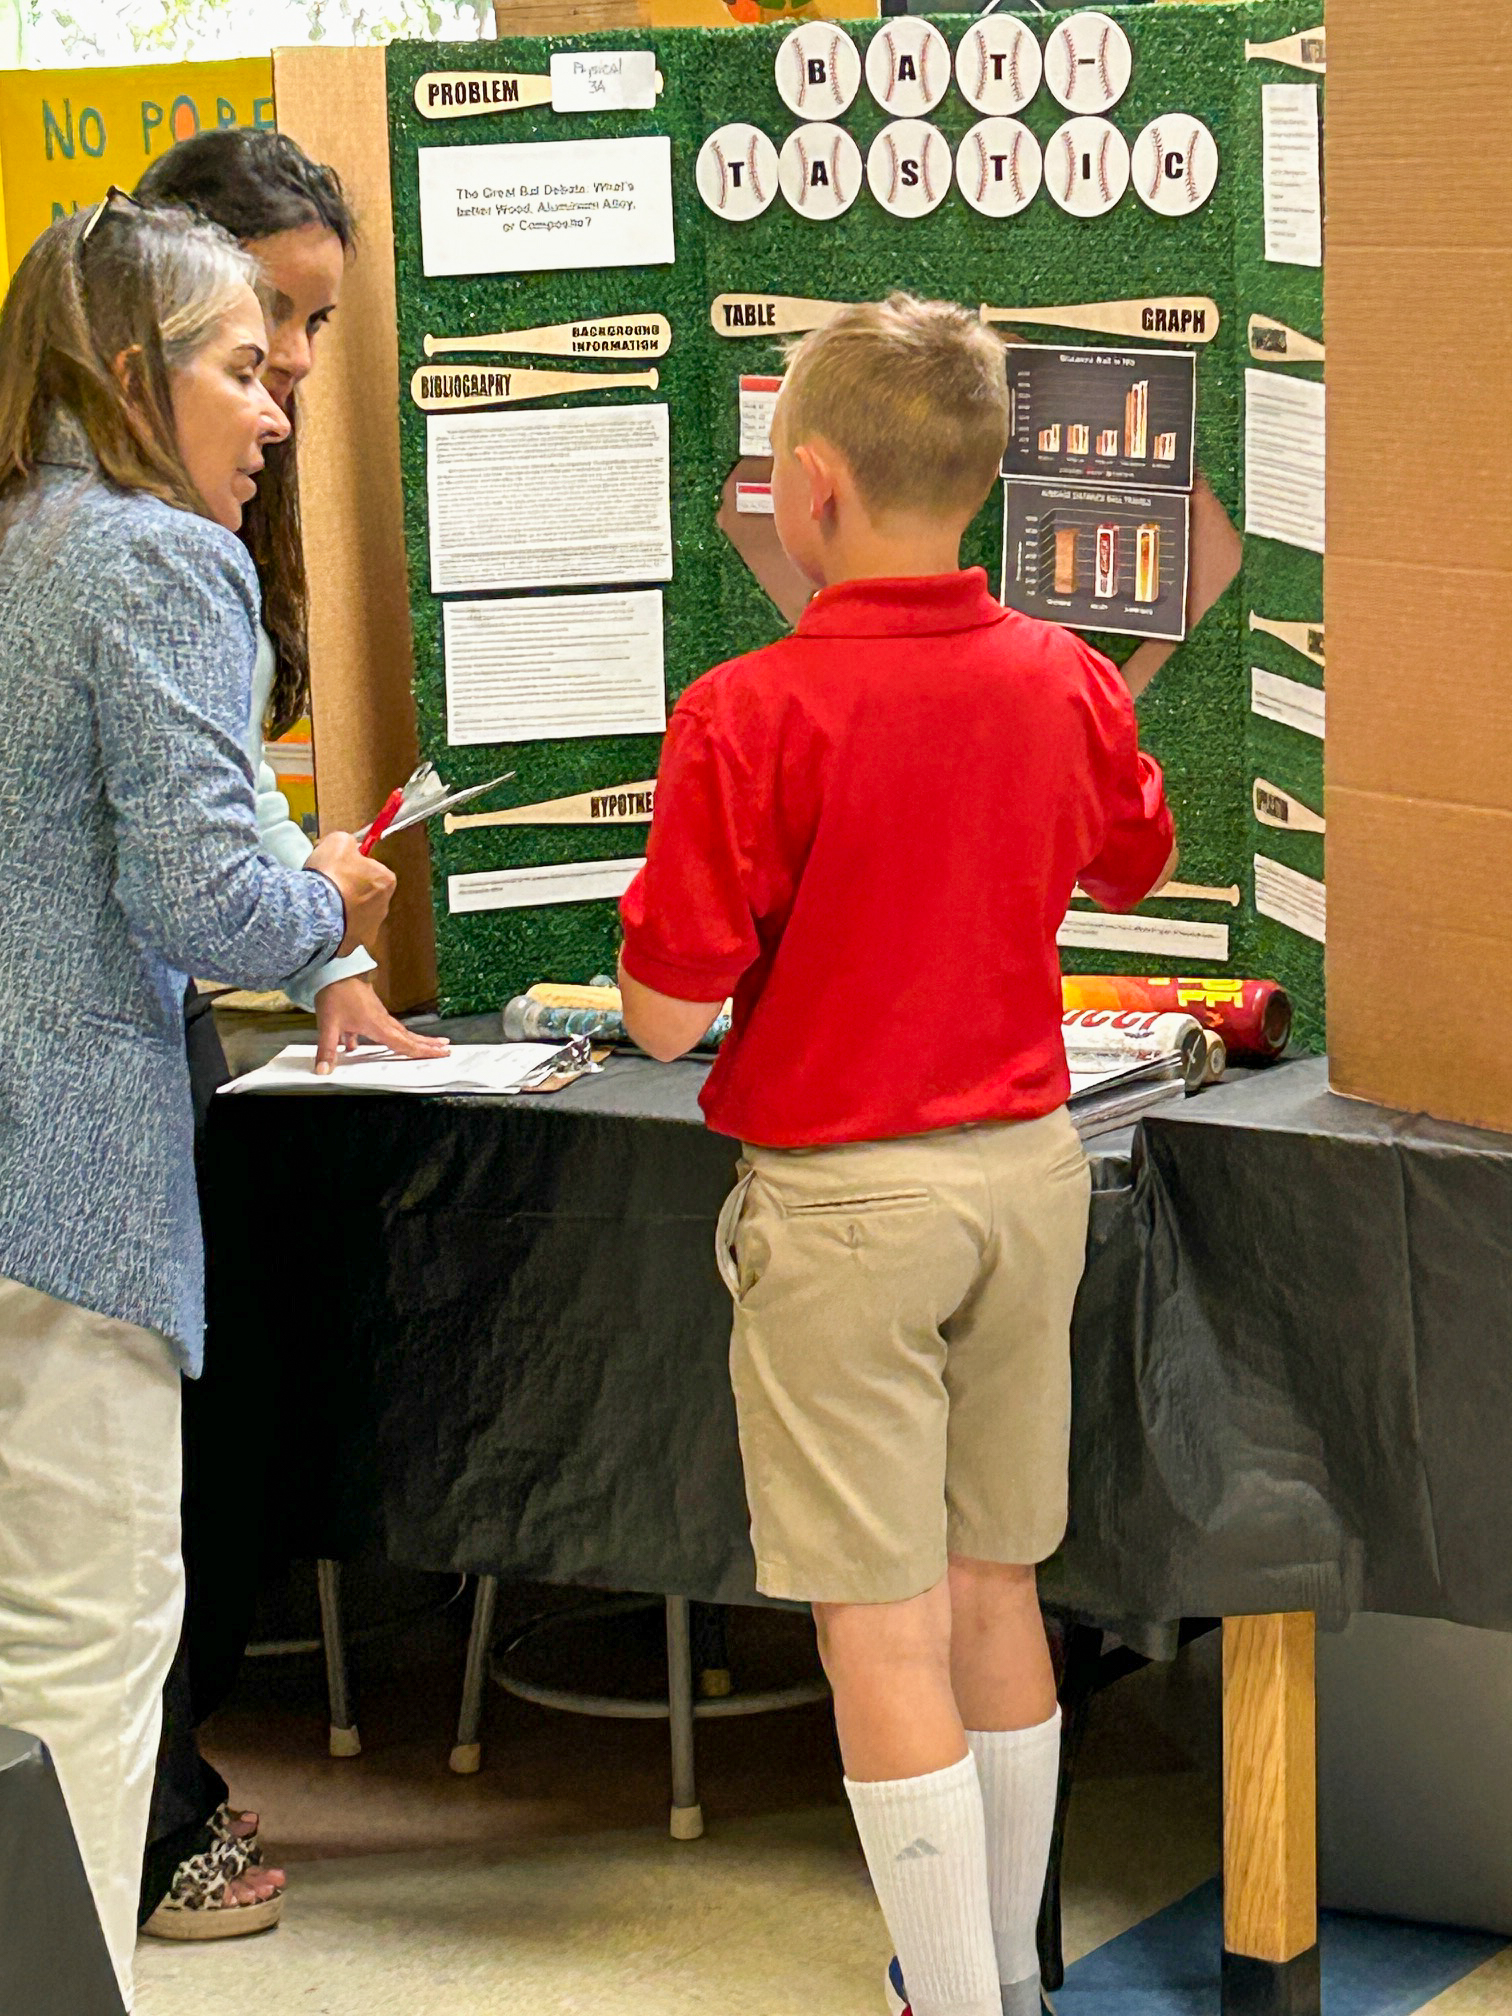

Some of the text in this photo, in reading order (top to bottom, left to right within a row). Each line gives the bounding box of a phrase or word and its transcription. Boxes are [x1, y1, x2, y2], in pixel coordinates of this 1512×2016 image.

[427, 79, 520, 107] PROBLEM
[41, 97, 107, 161] NO
[722, 302, 776, 328] TABLE
[1141, 307, 1206, 334] GRAPH
[572, 325, 661, 338] BACKGROUND
[572, 340, 660, 353] INFORMATION
[420, 373, 512, 399] BIBLIOGRAPHY
